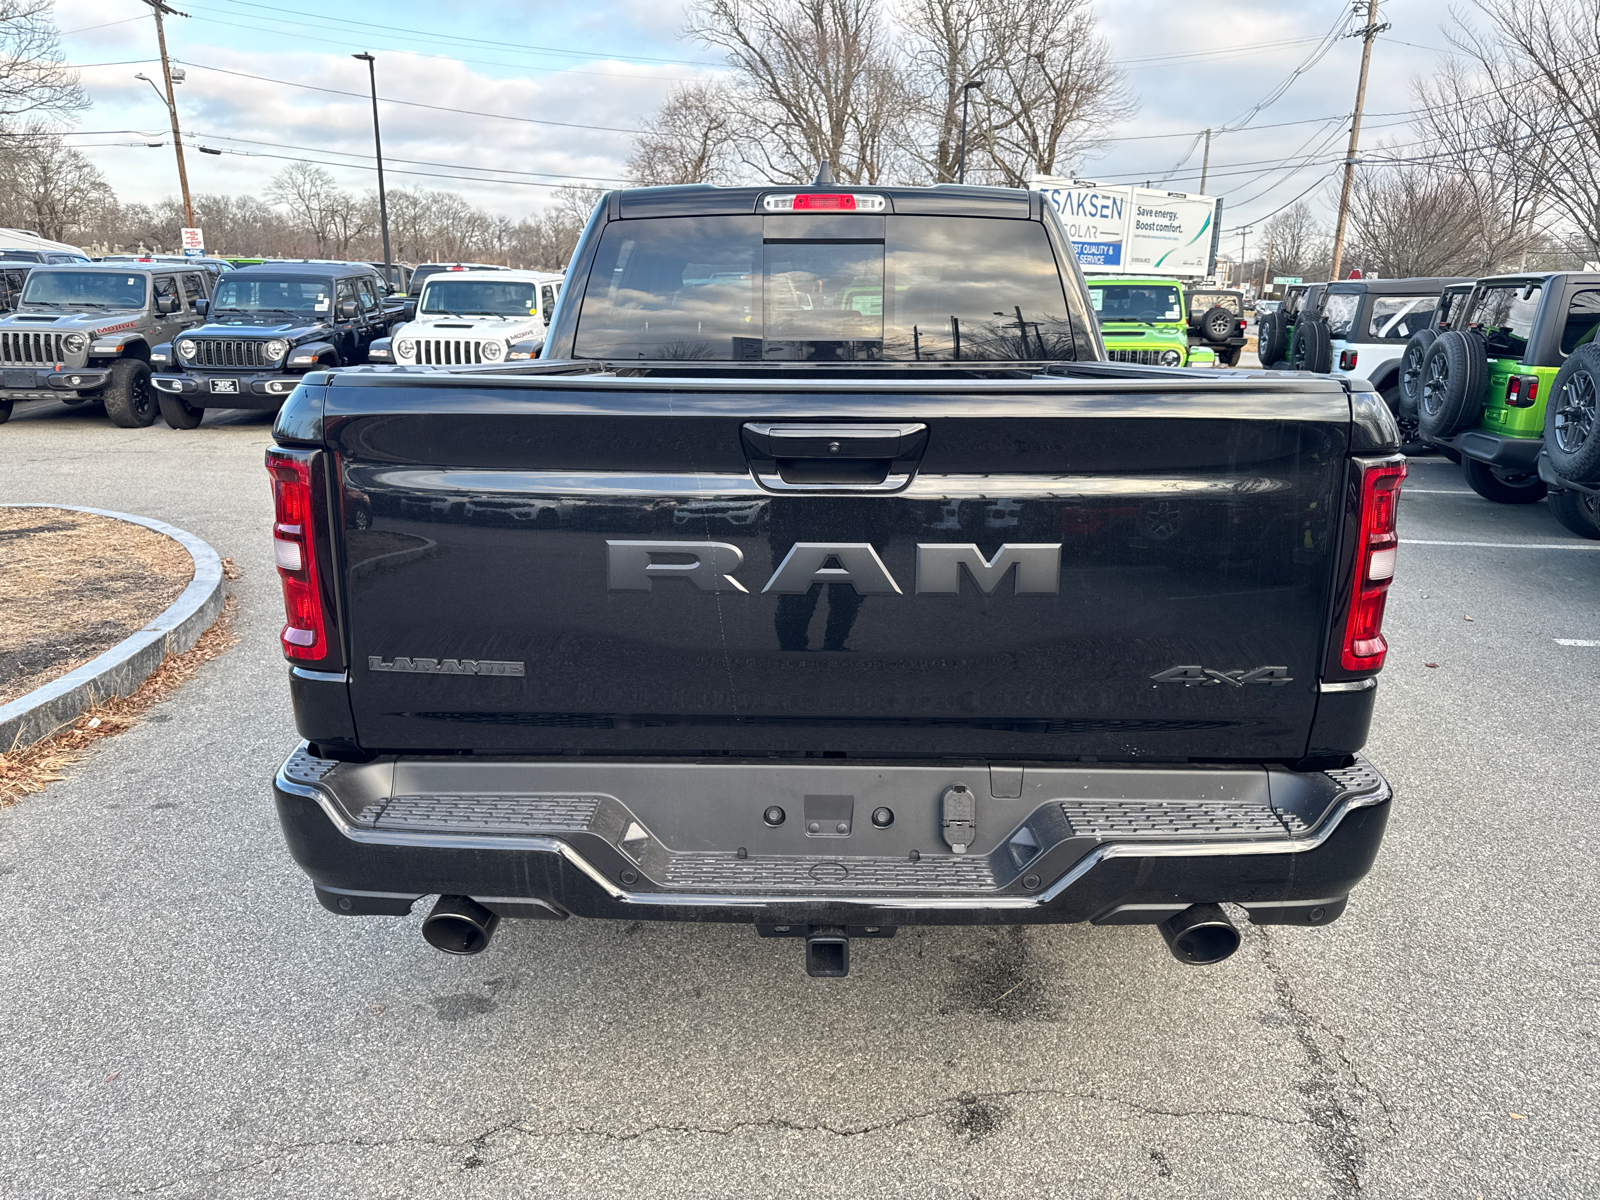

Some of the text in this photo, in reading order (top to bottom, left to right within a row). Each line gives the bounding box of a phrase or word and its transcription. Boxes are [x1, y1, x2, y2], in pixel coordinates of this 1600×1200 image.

[1040, 188, 1123, 220] SAKSEN
[1137, 206, 1178, 221] Save energy.
[1135, 219, 1183, 233] Boost comfort.
[1083, 244, 1108, 255] QUALITY
[1108, 246, 1113, 255] &
[1079, 254, 1105, 264] SERVICE
[96, 321, 137, 334] MOJAVE
[605, 540, 1064, 595] RAM
[368, 655, 526, 677] LARAMIE
